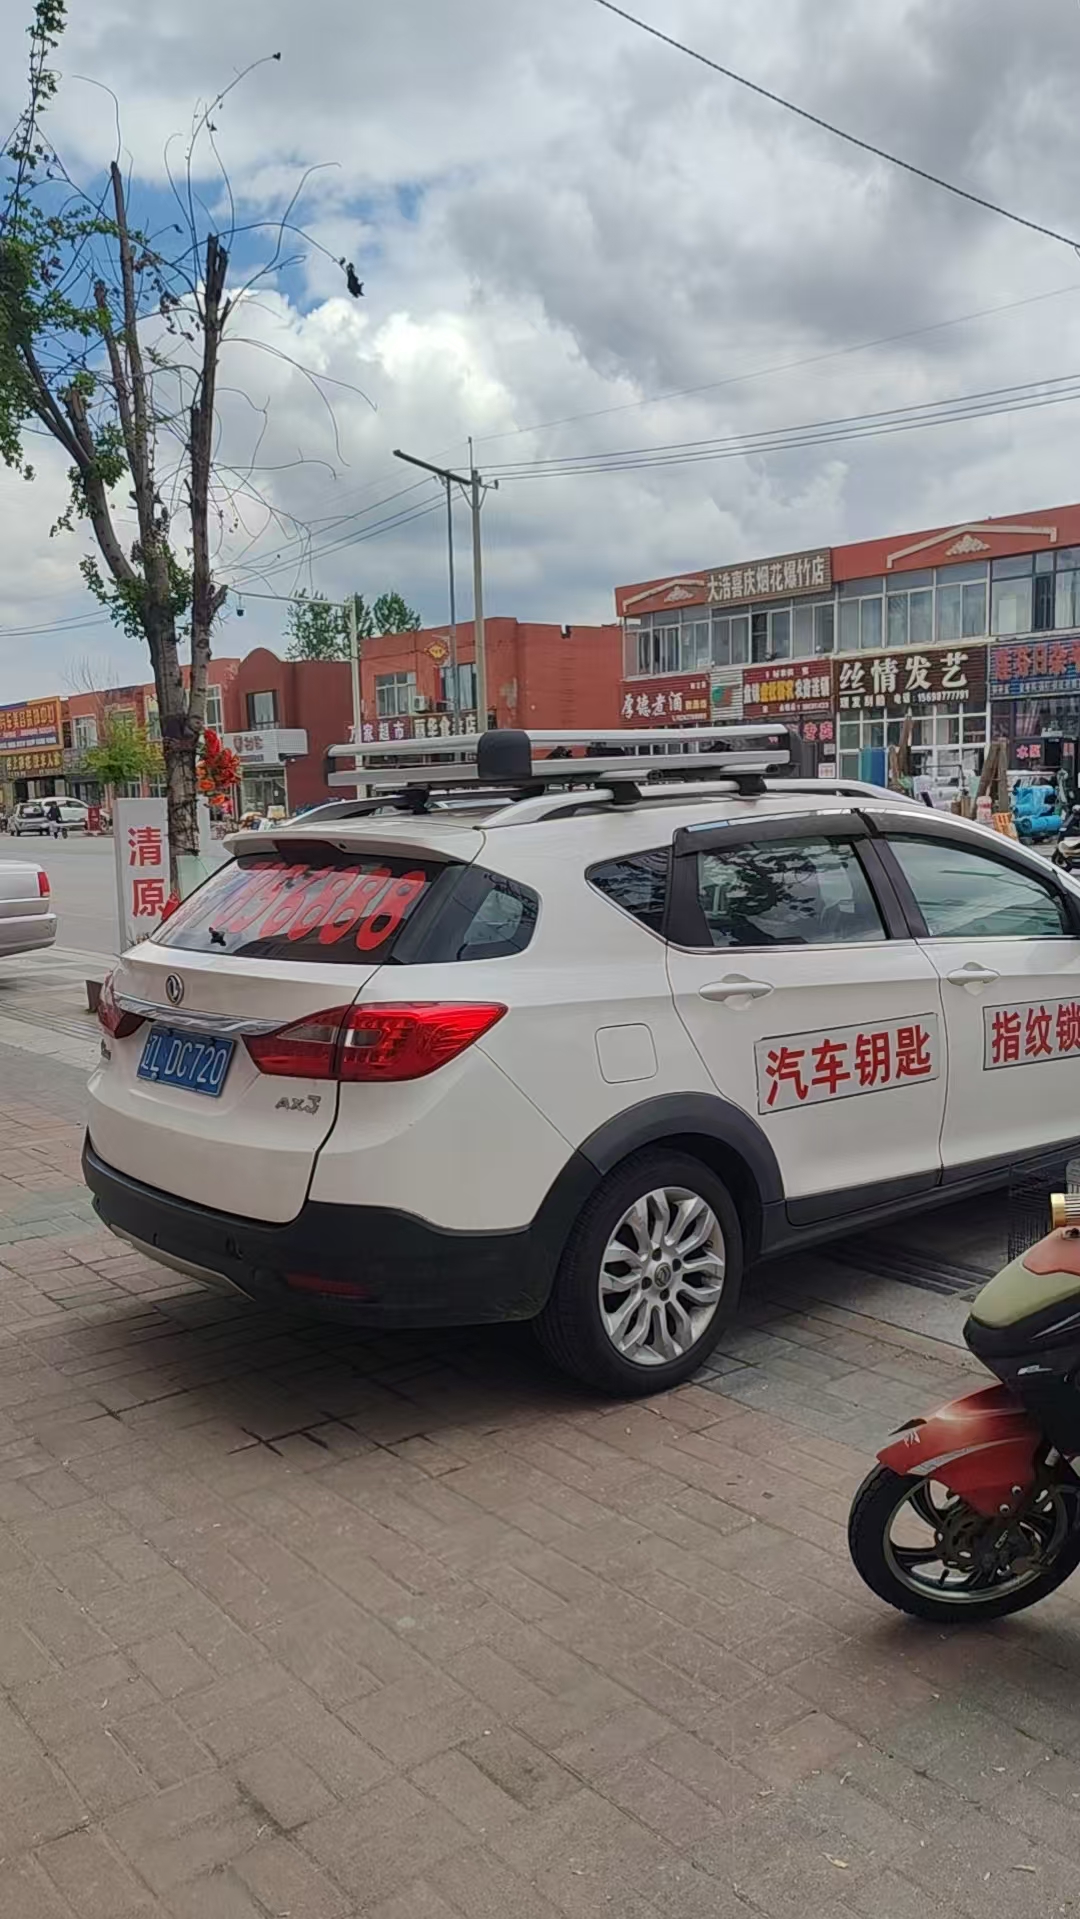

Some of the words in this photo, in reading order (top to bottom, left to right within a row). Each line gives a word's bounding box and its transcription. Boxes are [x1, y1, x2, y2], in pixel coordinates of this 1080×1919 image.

[838, 651, 970, 696] 丝情发艺
[127, 825, 167, 919] 清原
[765, 1023, 933, 1107] 汽车钥匙
[991, 1001, 1080, 1064] 指纹锁
